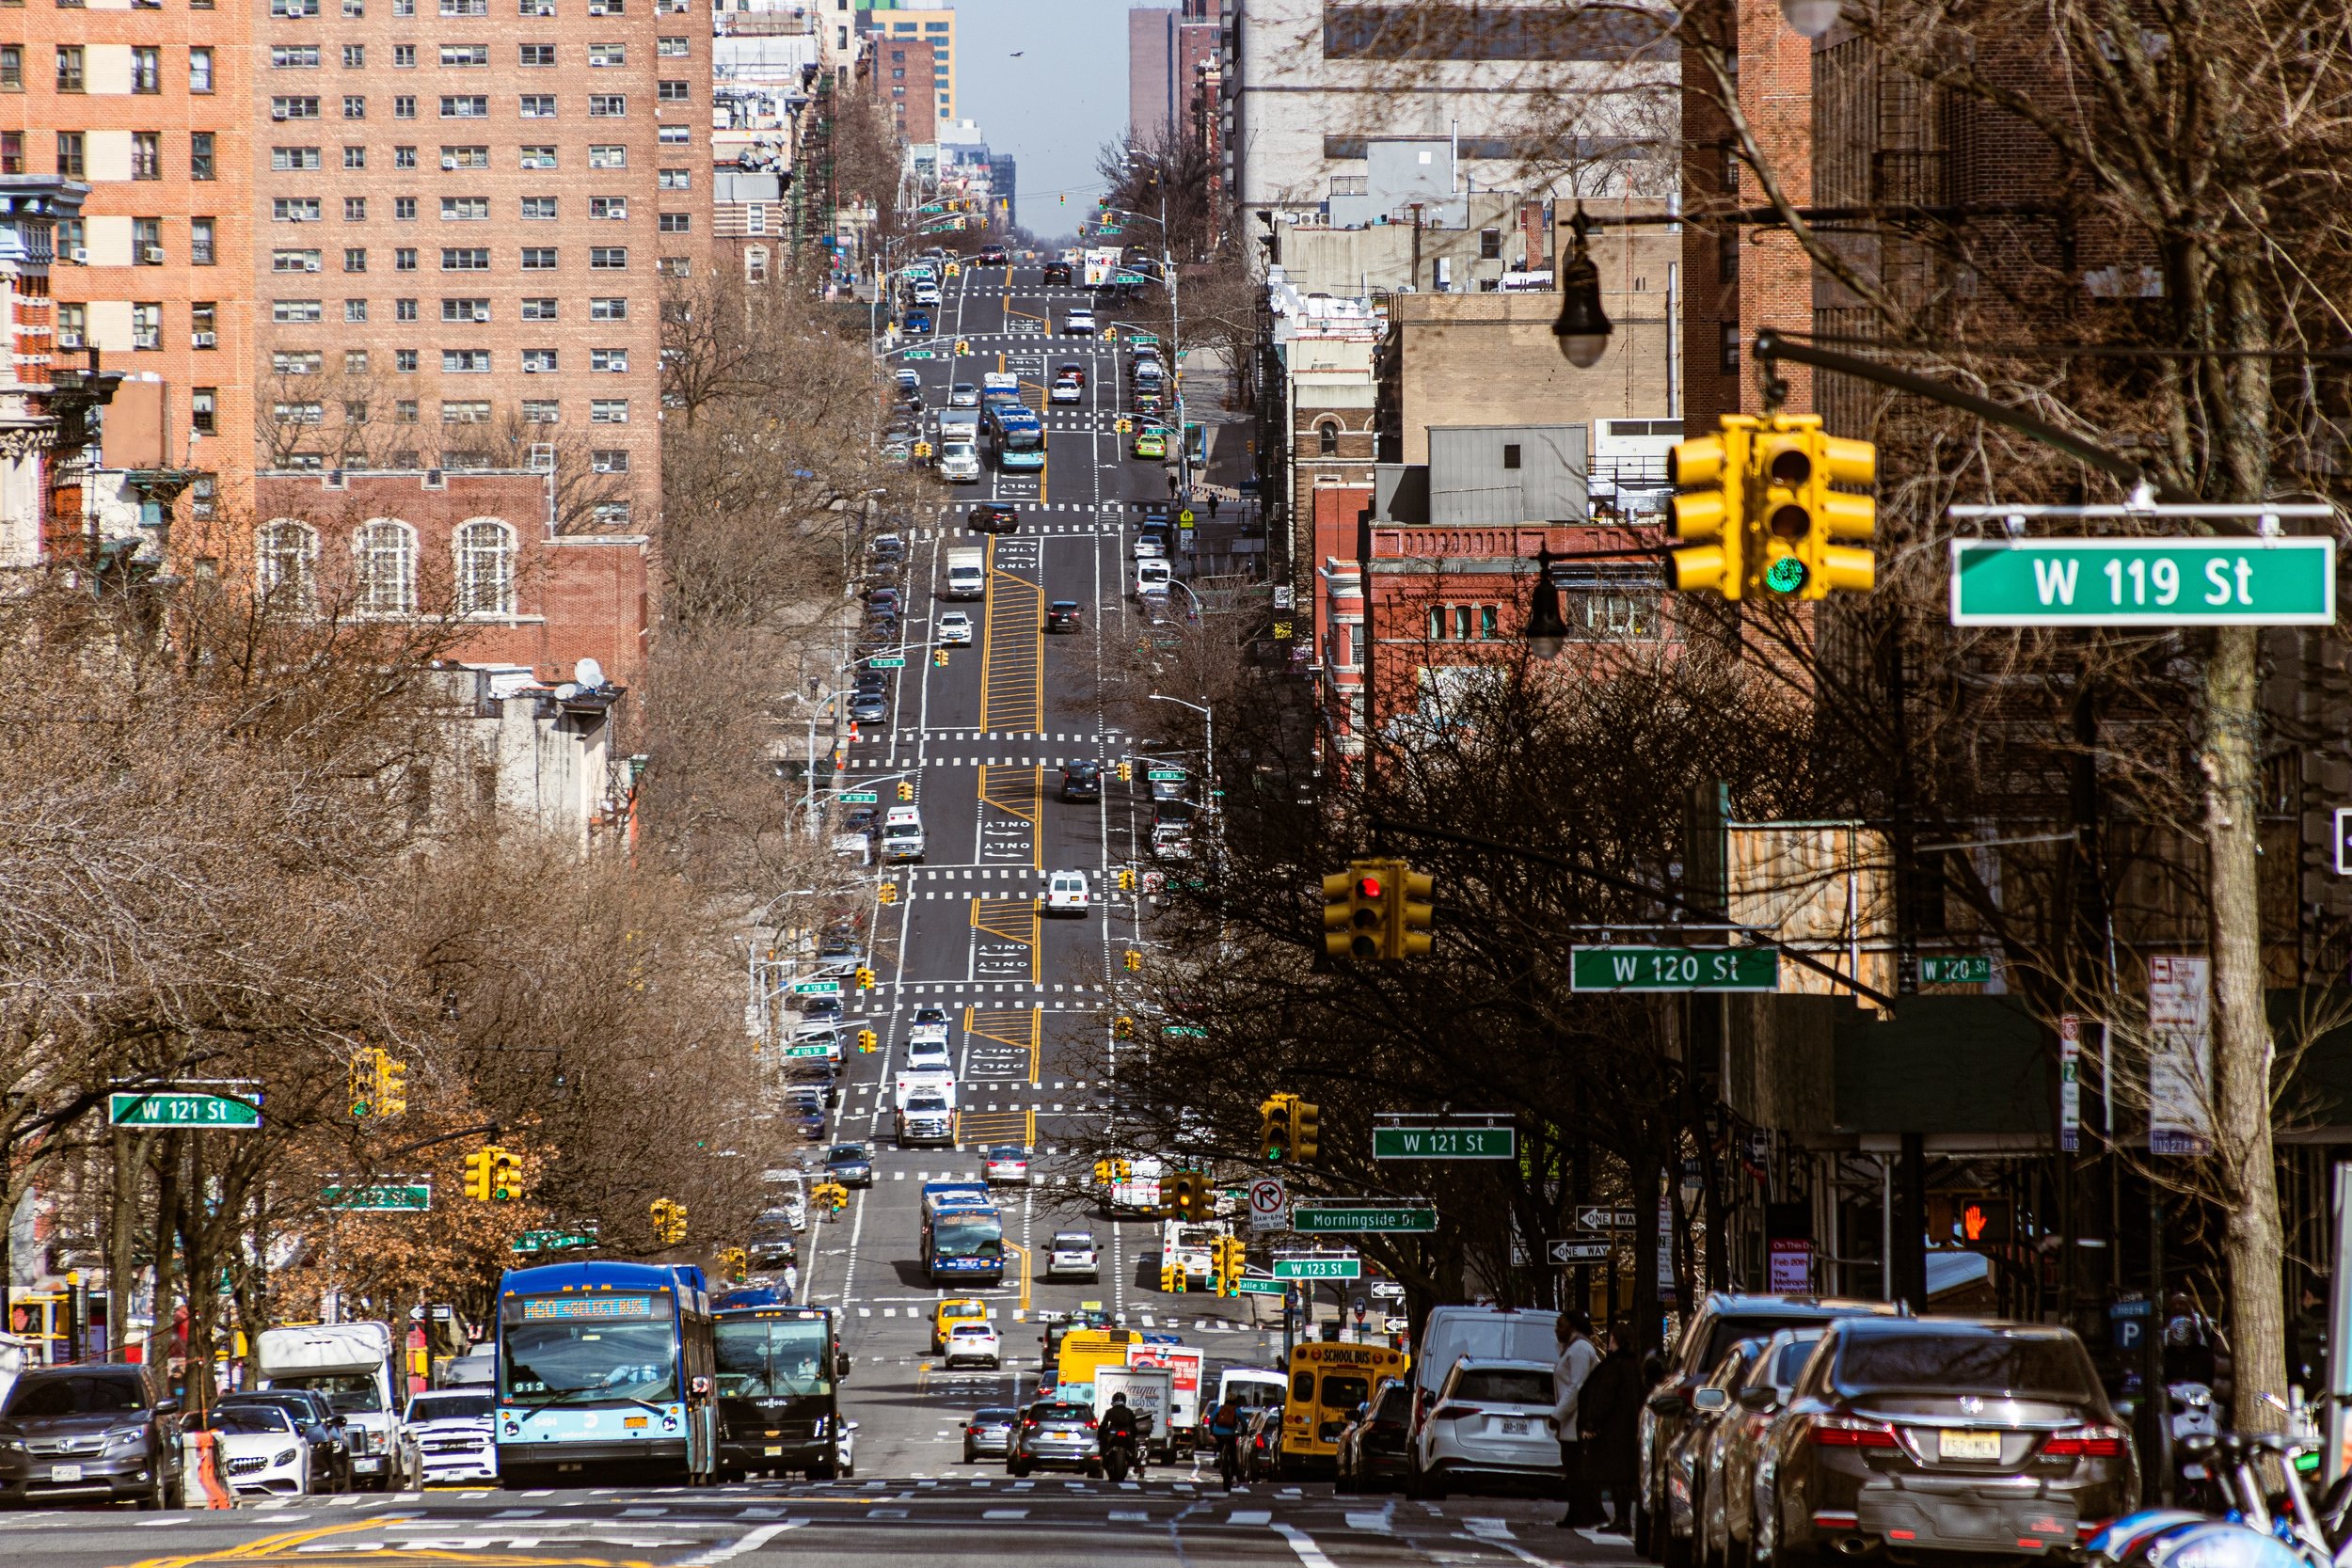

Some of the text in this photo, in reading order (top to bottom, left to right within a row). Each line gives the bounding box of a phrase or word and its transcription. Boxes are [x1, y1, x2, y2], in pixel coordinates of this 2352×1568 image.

[1088, 257, 1114, 265] FedEx
[2033, 556, 2254, 606] W 119 St
[1613, 955, 1740, 982] W 120 St
[1924, 959, 1987, 980] W 120 St
[142, 1101, 228, 1121] W 121 St
[1404, 1134, 1485, 1153] W 121 St
[1253, 1213, 1284, 1222] 8AM-6PM
[1313, 1212, 1415, 1229] Morningside Dr
[1587, 1214, 1637, 1225] ONE WA
[1558, 1246, 1608, 1257] ONE WAY
[1291, 1263, 1343, 1275] W 123 St
[1260, 1282, 1268, 1291] St
[2123, 1323, 2140, 1347] P
[1324, 1349, 1371, 1364] SCHOOL BUS
[514, 1382, 546, 1392] 913
